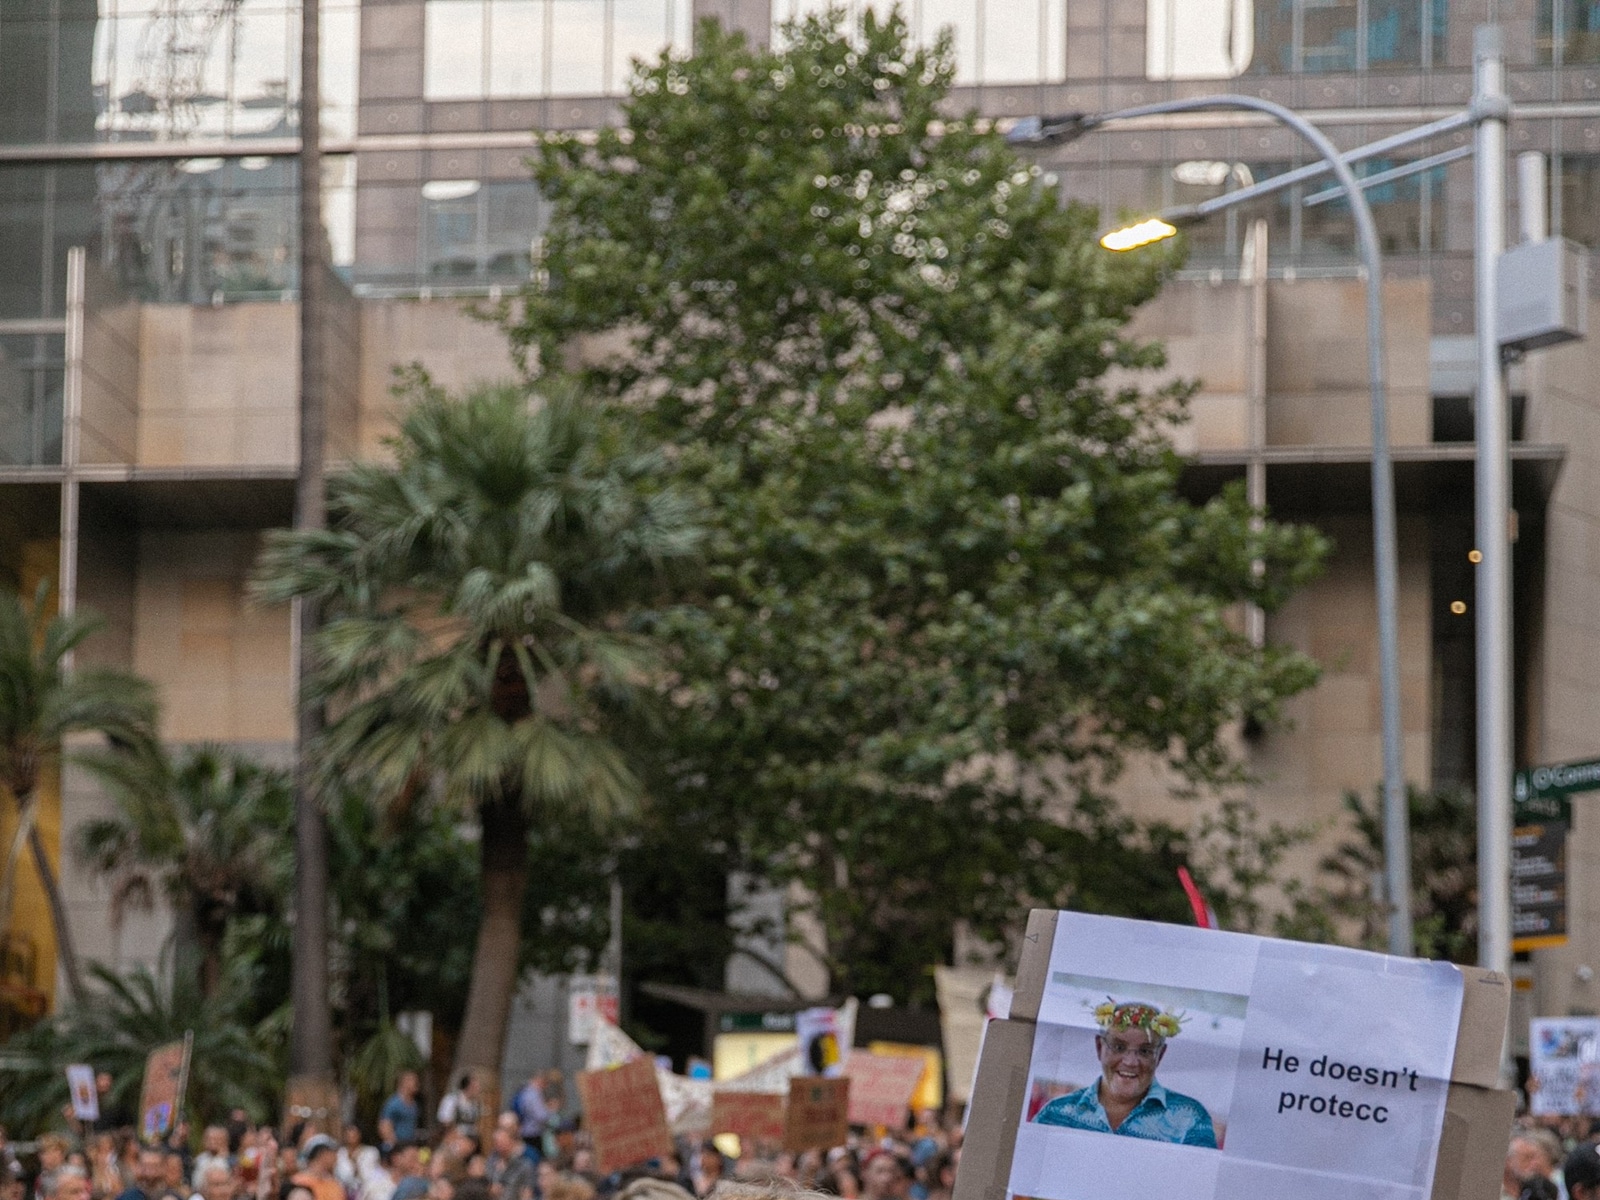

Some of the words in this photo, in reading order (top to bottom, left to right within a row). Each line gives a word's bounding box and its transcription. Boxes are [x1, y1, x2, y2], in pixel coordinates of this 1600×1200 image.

[1262, 1047, 1300, 1073] He
[1309, 1055, 1419, 1091] doesn't
[1278, 1091, 1389, 1123] protecc
